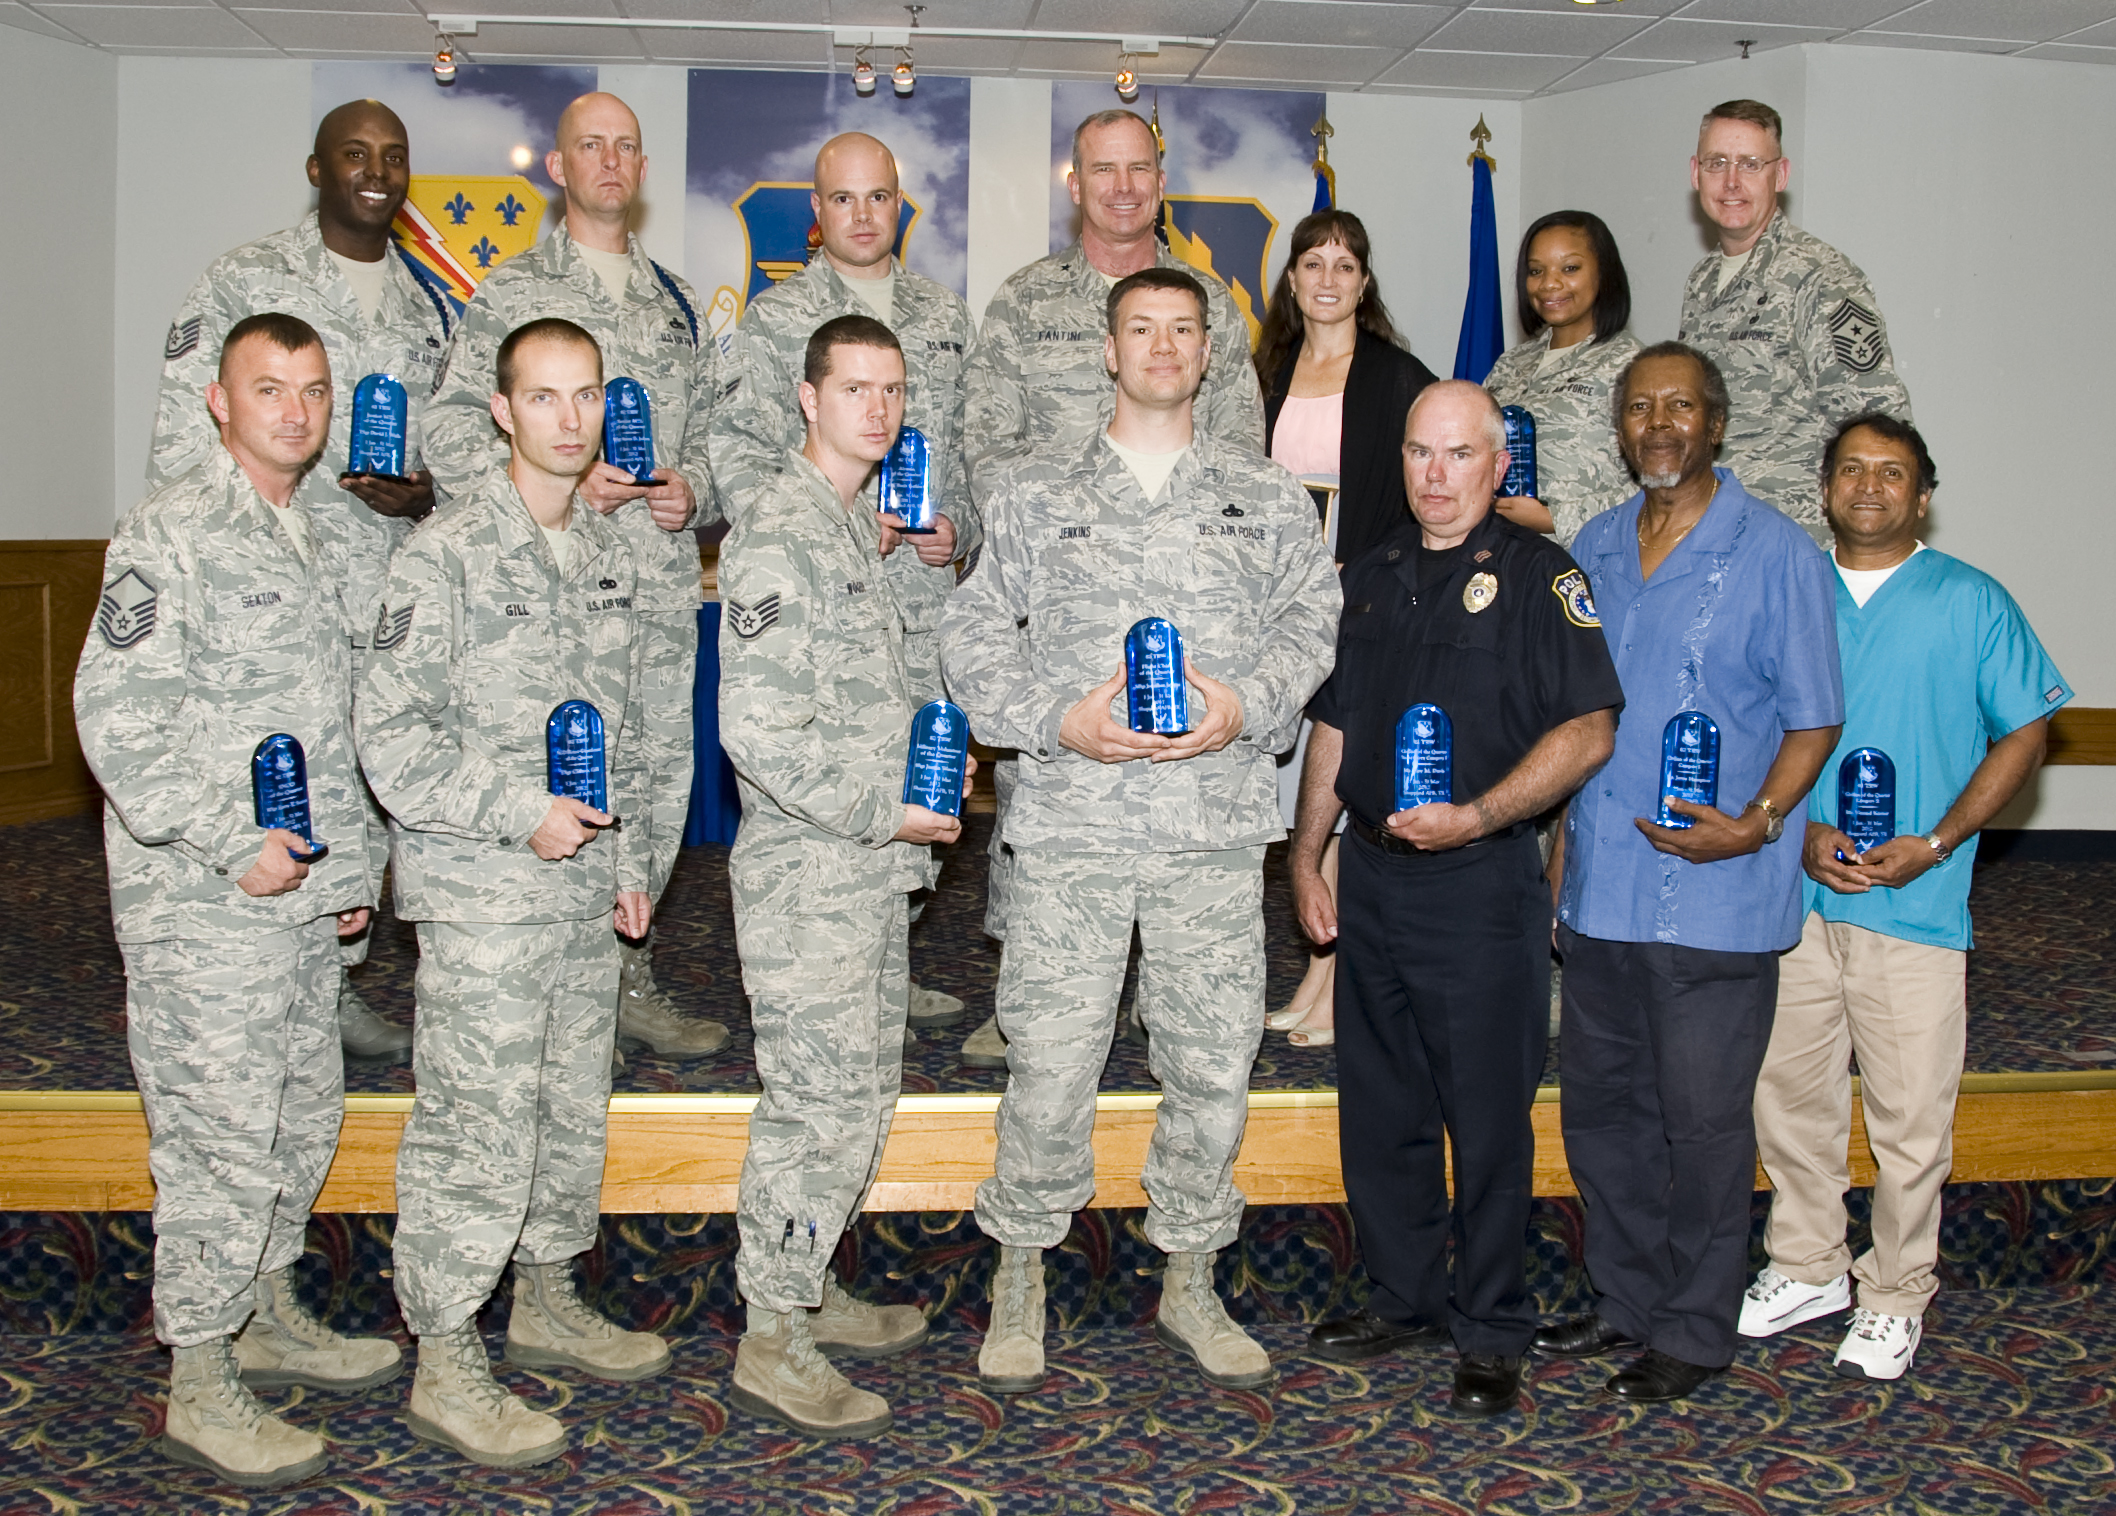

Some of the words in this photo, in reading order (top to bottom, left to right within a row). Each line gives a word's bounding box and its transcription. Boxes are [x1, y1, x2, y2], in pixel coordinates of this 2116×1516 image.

[1038, 330, 1081, 341] FANTINI
[1567, 383, 1594, 397] FORCE
[1059, 525, 1091, 539] JENKINS
[1199, 524, 1216, 536] U.S.
[1221, 525, 1236, 537] AIR
[1239, 525, 1266, 541] FORCE
[1558, 575, 1582, 595] POL
[241, 591, 281, 609] SEXTON
[602, 599, 614, 610] AIR
[505, 604, 530, 617] GILL
